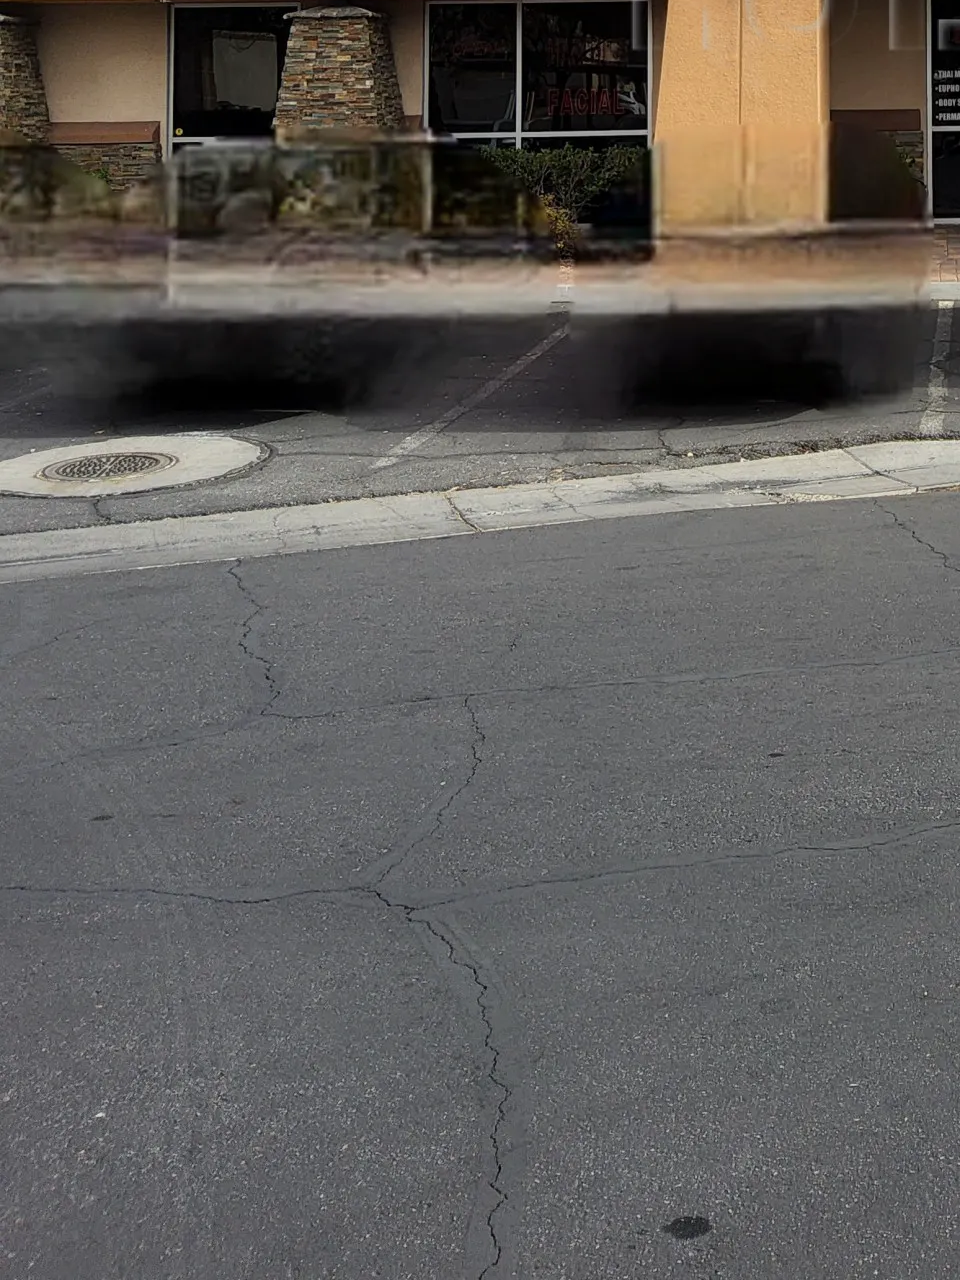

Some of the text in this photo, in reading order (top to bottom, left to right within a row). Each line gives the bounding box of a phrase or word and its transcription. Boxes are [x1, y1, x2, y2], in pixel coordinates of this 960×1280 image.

[938, 70, 953, 78] THAI
[547, 89, 625, 115] FACIAL
[938, 99, 956, 107] BODY
